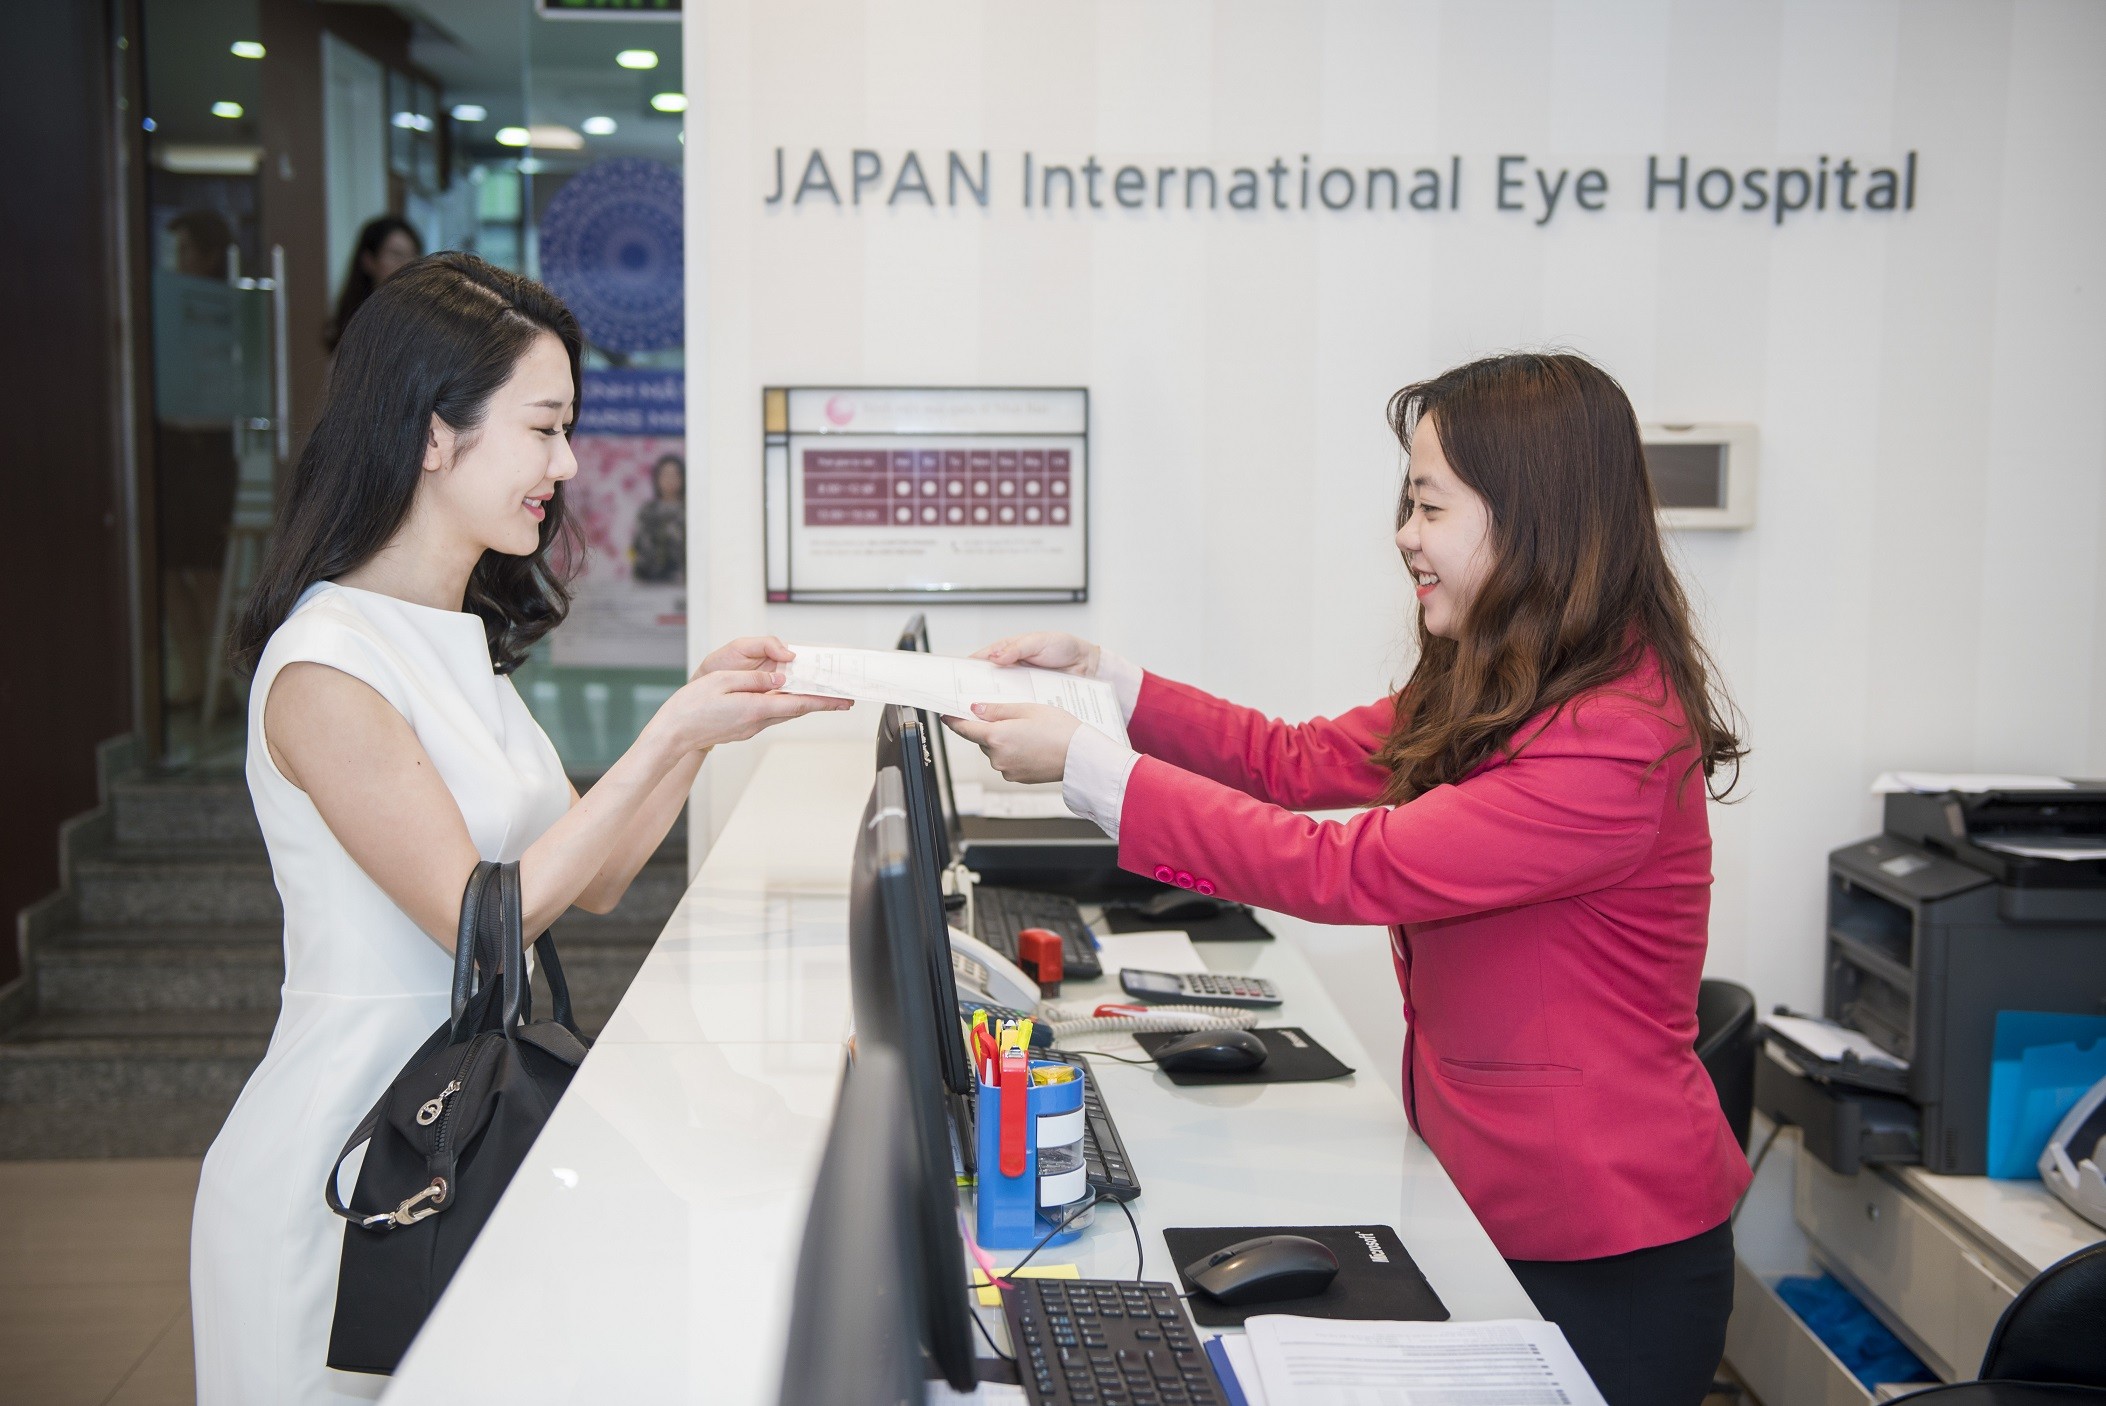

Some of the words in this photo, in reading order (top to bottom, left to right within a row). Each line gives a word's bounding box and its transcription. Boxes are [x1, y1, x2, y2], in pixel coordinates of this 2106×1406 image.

[765, 147, 988, 207] JAPAN
[1024, 152, 1461, 211] International
[1497, 154, 1609, 226] Eye
[1647, 150, 1918, 226] Hospital
